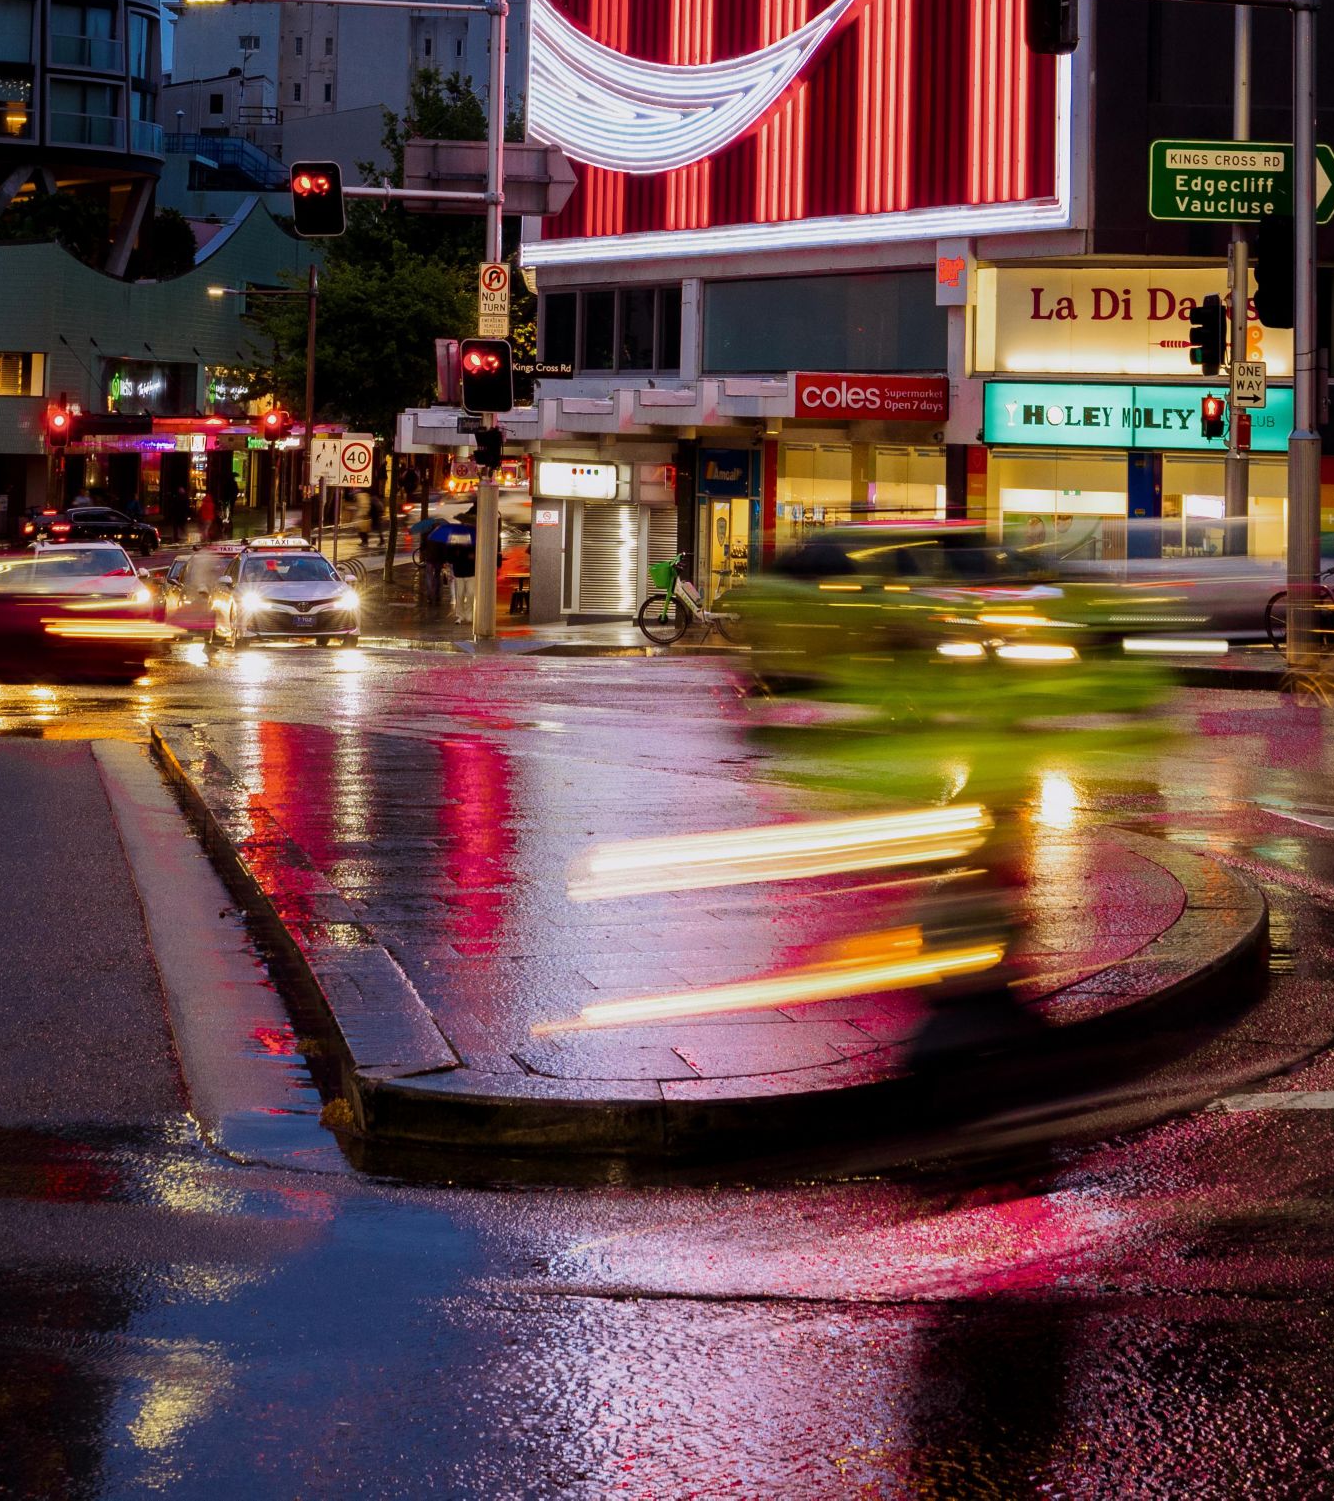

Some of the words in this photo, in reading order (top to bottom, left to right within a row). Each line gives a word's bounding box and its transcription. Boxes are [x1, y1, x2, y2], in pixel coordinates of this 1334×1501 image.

[1170, 154, 1209, 165] KINGS
[1215, 155, 1257, 166] CROSS
[1263, 156, 1281, 167] RD
[1175, 175, 1274, 196] Edgecliff
[1175, 196, 1275, 214] Vaucluse
[482, 292, 496, 302] NO
[501, 293, 507, 302] U
[483, 304, 506, 312] TURN
[1030, 288, 1078, 320] La
[1091, 288, 1133, 320] Di
[512, 363, 534, 373] Kings
[536, 363, 558, 372] Cross
[561, 364, 571, 373] Rd
[1238, 366, 1261, 377] ONE
[1236, 380, 1262, 391] WAY
[802, 381, 881, 409] coles
[884, 388, 943, 400] Supermarket
[884, 401, 911, 412] Open
[912, 402, 918, 410] 7
[920, 401, 943, 412] days
[1023, 405, 1113, 427] HOLEY
[1122, 407, 1195, 429] MOLEY
[347, 452, 367, 464] 40
[342, 475, 369, 484] AREA
